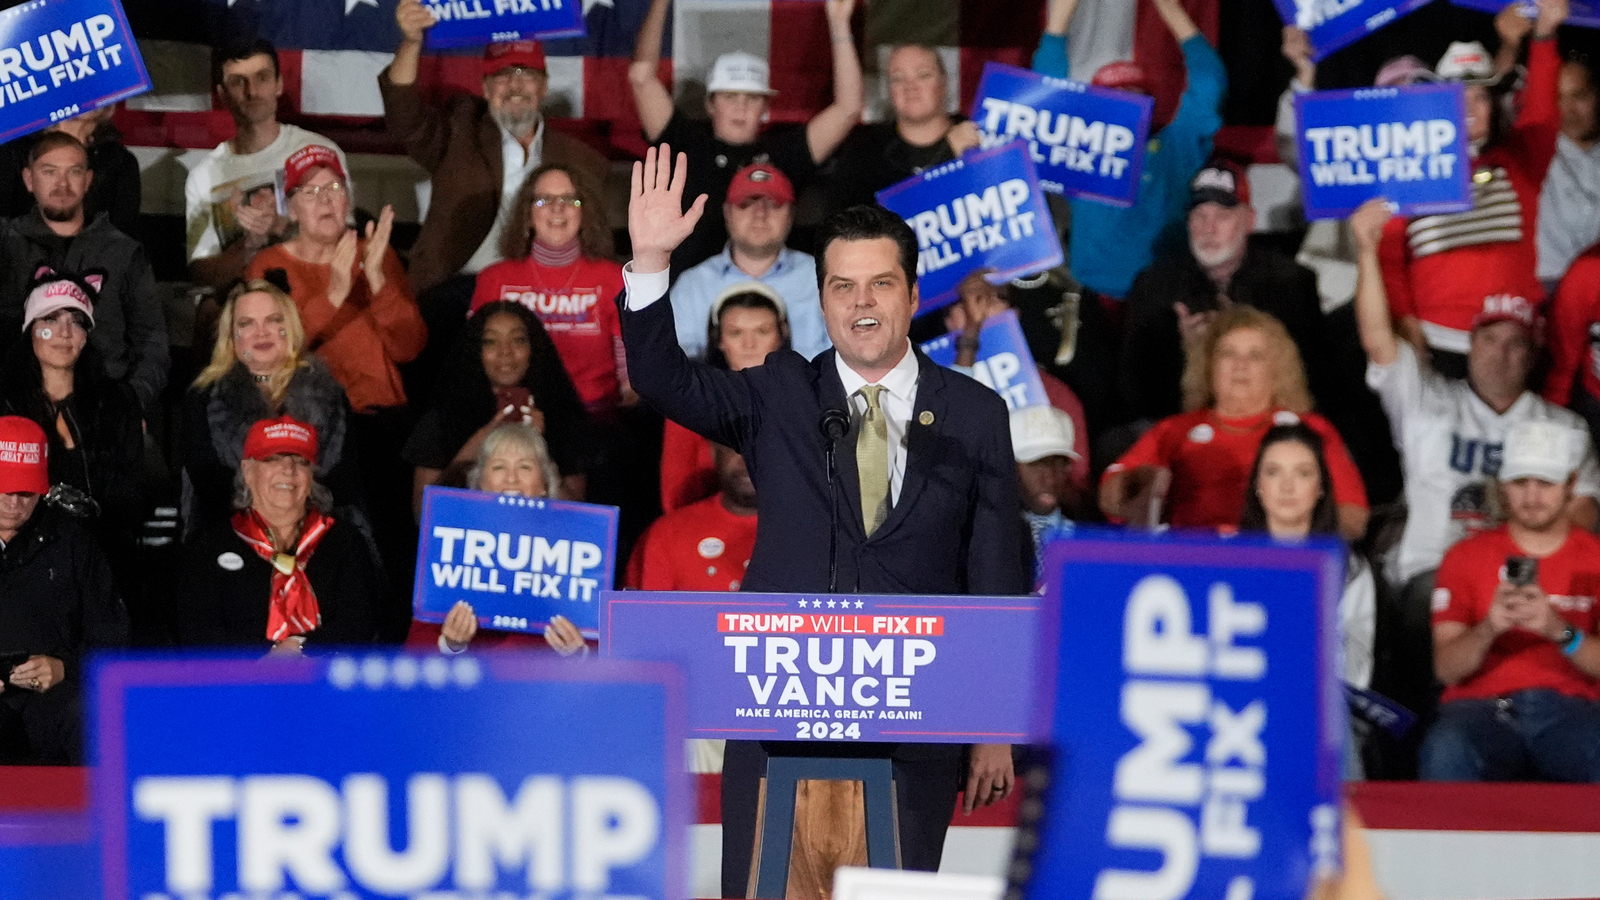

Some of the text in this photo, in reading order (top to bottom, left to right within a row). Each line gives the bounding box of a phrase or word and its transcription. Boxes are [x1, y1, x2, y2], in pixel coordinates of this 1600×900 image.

[49, 55, 96, 88] FIX
[97, 43, 122, 71] IT
[49, 103, 80, 122] 2024
[982, 97, 1134, 156] TRUMP
[1305, 119, 1457, 162] TRUMP
[1050, 145, 1097, 174] FIX
[1099, 155, 1129, 180] IT
[1310, 153, 1458, 188] WILL FIX IT
[960, 222, 1007, 257] FIX
[1007, 211, 1035, 242] IT
[504, 291, 598, 315] TRUMP
[0, 441, 17, 451] MAKE
[1, 451, 22, 463] GREAT
[433, 526, 602, 577] TRUMP
[431, 563, 599, 602] WILL FIX IT
[492, 614, 528, 629] 2024
[724, 614, 938, 634] TRUMP WILL FIX IT
[724, 636, 937, 676] TRUMP
[747, 675, 911, 707] VANCE
[735, 708, 922, 720] MAKE AMERICA GREAT AGAIN!
[795, 721, 861, 739] 2024
[133, 772, 663, 896] TRUMP
